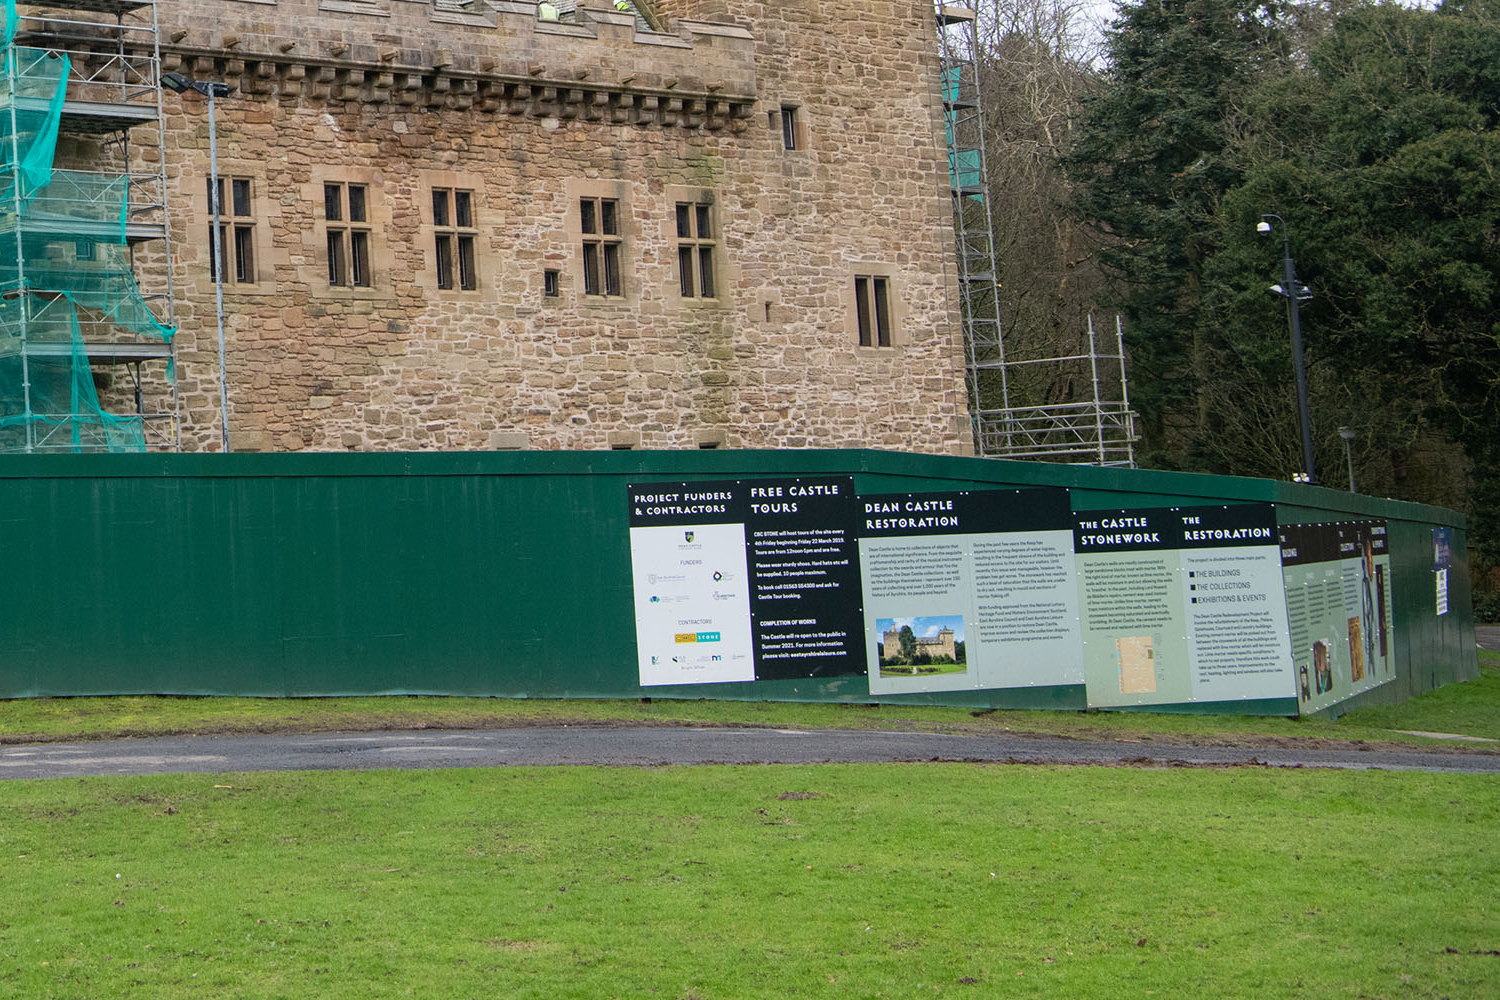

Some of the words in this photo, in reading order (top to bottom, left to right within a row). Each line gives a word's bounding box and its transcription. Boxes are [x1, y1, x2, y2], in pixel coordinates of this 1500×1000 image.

[634, 494, 679, 503] PROJECT
[684, 492, 732, 500] FUNDERS
[750, 487, 782, 498] FREE
[789, 485, 838, 496] CASTLE
[646, 505, 726, 515] CONTRACTORS
[750, 502, 798, 514] TOURS
[865, 502, 900, 513] DEAN
[905, 500, 953, 511] CASTLE
[866, 516, 958, 529] RESTORATION
[1102, 517, 1147, 528] CASTLE
[1081, 533, 1160, 545] STONEWORK
[1184, 528, 1271, 540] RESTORATION
[1210, 582, 1251, 590] COLLECTIONS
[1198, 596, 1235, 604] EXHIBITIONS
